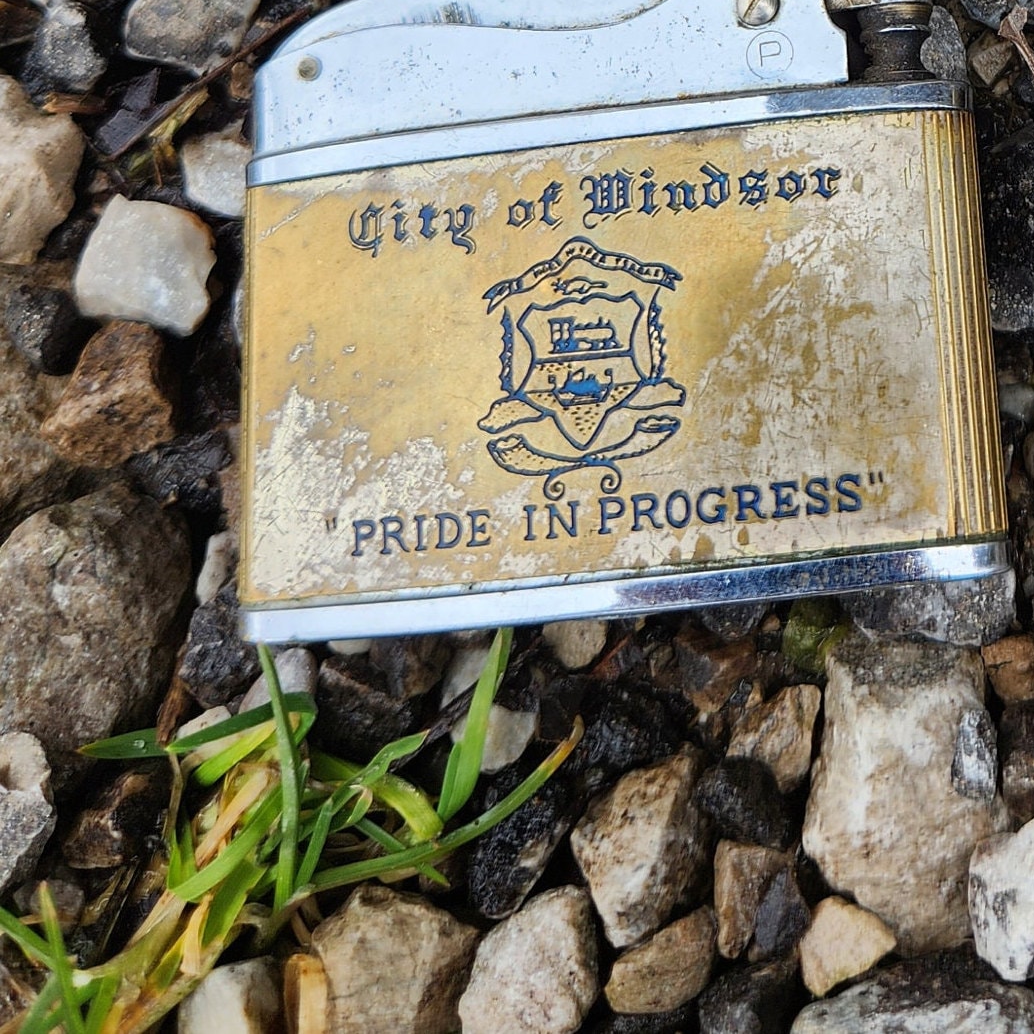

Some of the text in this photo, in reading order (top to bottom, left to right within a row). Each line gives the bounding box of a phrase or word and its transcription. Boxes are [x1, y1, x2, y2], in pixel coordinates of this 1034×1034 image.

[759, 40, 782, 67] P
[349, 161, 844, 257] City of Windsor
[523, 500, 579, 541] IN
[598, 471, 886, 535] PROGRESS"
